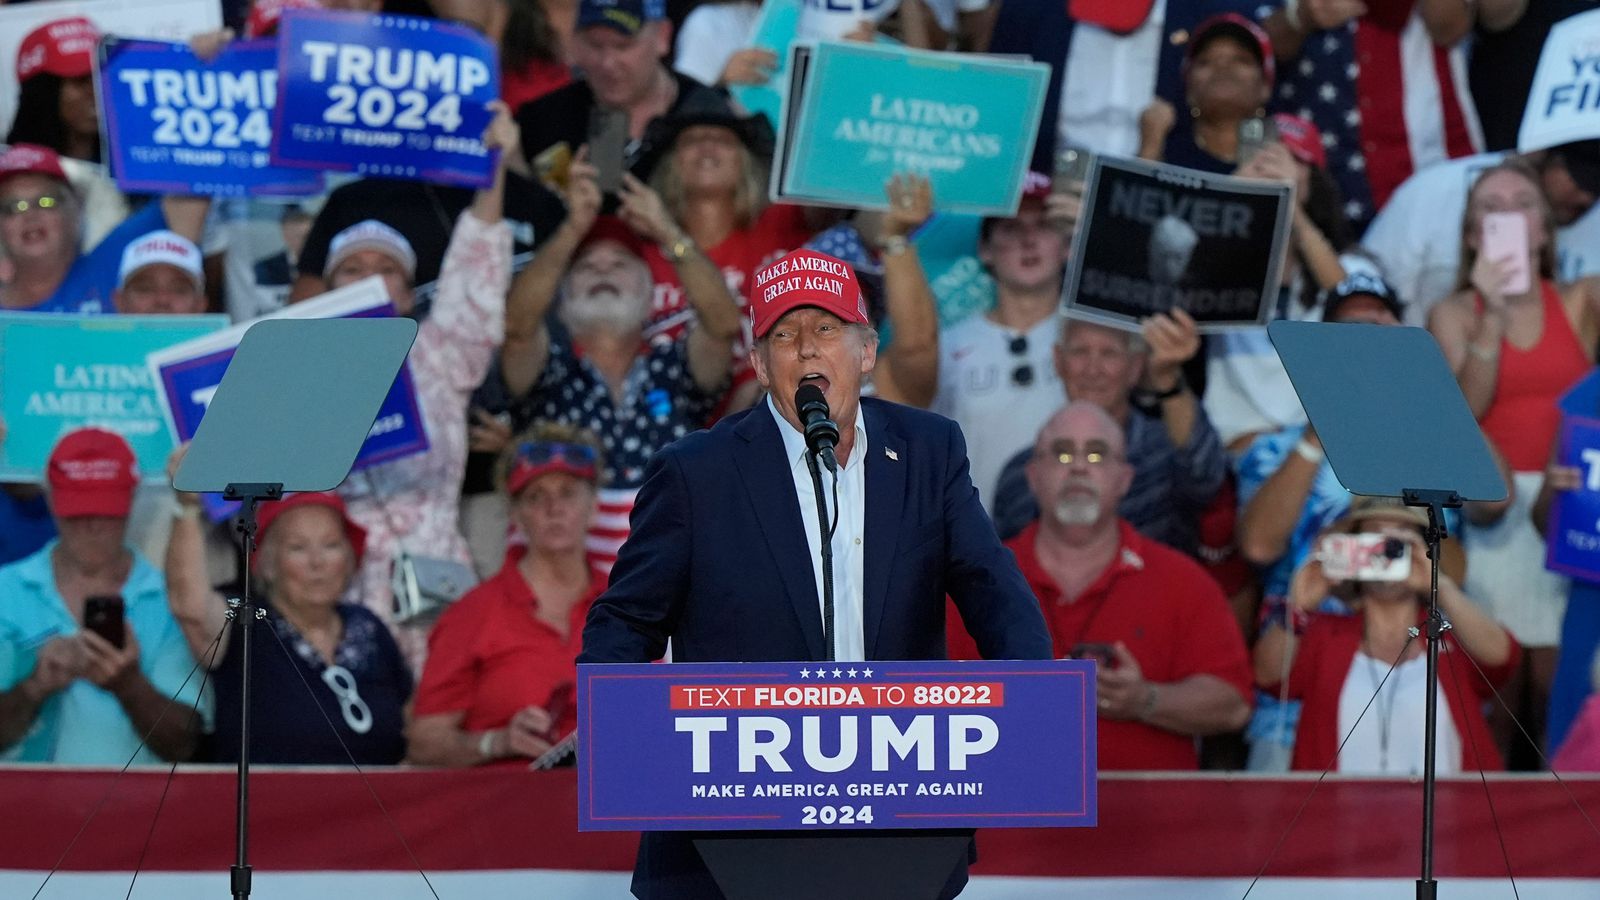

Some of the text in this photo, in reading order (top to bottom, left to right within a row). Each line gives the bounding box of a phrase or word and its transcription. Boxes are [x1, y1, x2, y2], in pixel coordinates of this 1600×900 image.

[302, 40, 490, 96] TRUMP
[323, 84, 463, 132] 2024
[869, 93, 979, 130] LATINO
[1545, 83, 1600, 118] FI
[151, 106, 273, 148] 2024
[833, 117, 1001, 158] AMERICANS
[1107, 176, 1254, 237] NEVER
[757, 260, 789, 288] MAKE
[790, 257, 850, 280] AMERICA
[764, 277, 802, 304] GREAT
[803, 276, 844, 298] AGAIN
[1080, 268, 1259, 315] SURRENDER
[683, 685, 992, 707] TEXT FLORIDA TO 88022
[675, 714, 1000, 774] TRUMP
[691, 781, 984, 798] MAKE AMERICA GREAT AGAIN!
[801, 805, 874, 825] 2024
